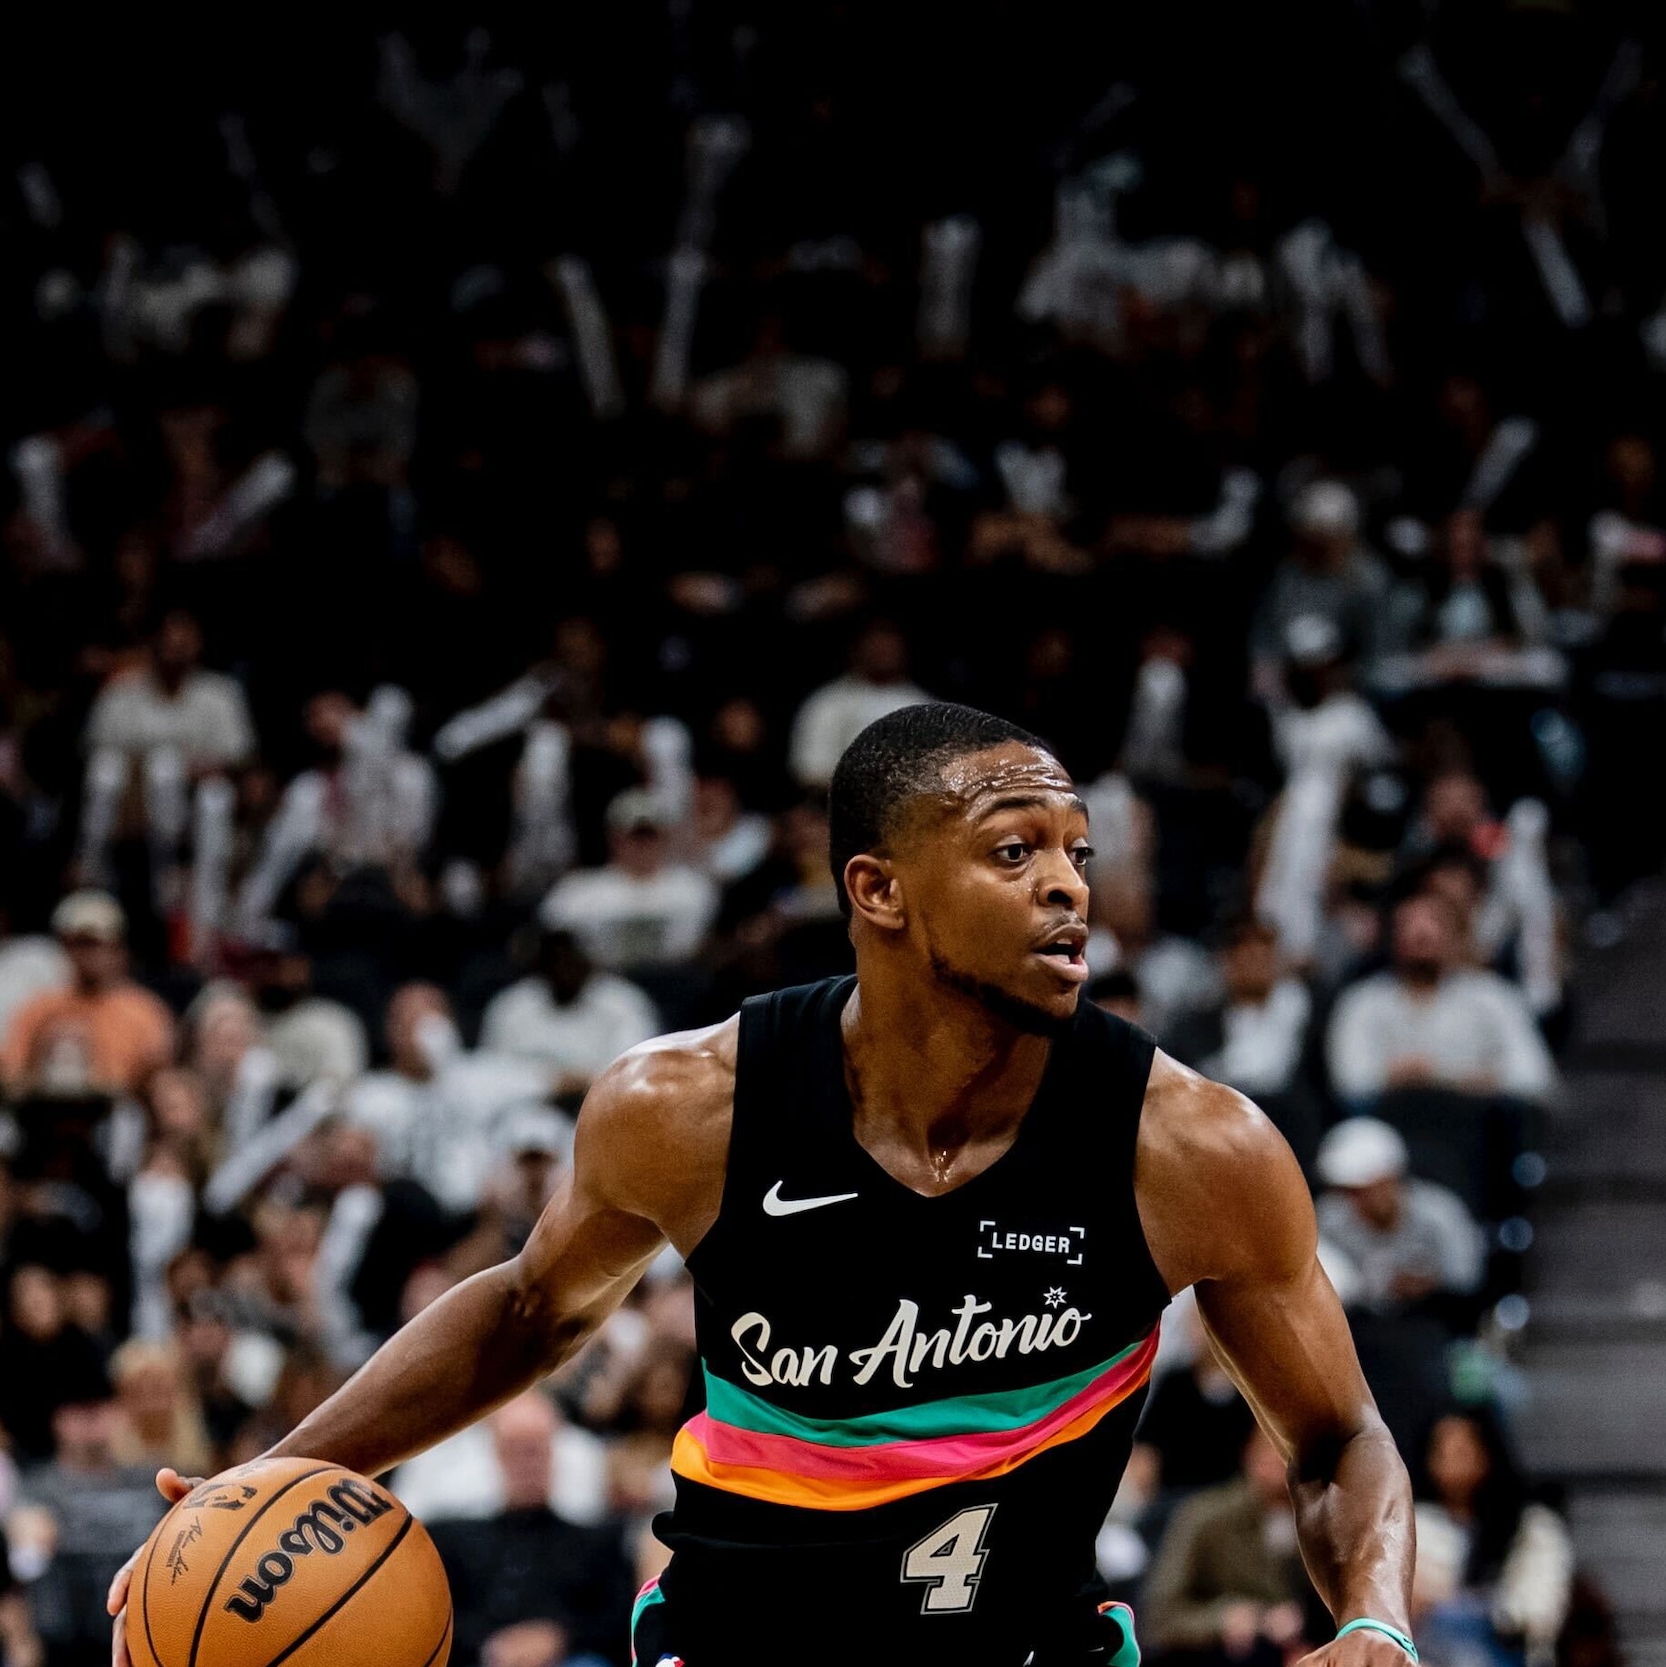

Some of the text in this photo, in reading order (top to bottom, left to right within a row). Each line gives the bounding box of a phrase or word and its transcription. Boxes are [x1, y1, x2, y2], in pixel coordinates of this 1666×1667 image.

[990, 1231, 1071, 1255] LEDGER
[730, 1288, 1092, 1388] San Antonio
[223, 1477, 396, 1623] Wilson
[900, 1503, 998, 1614] 4
